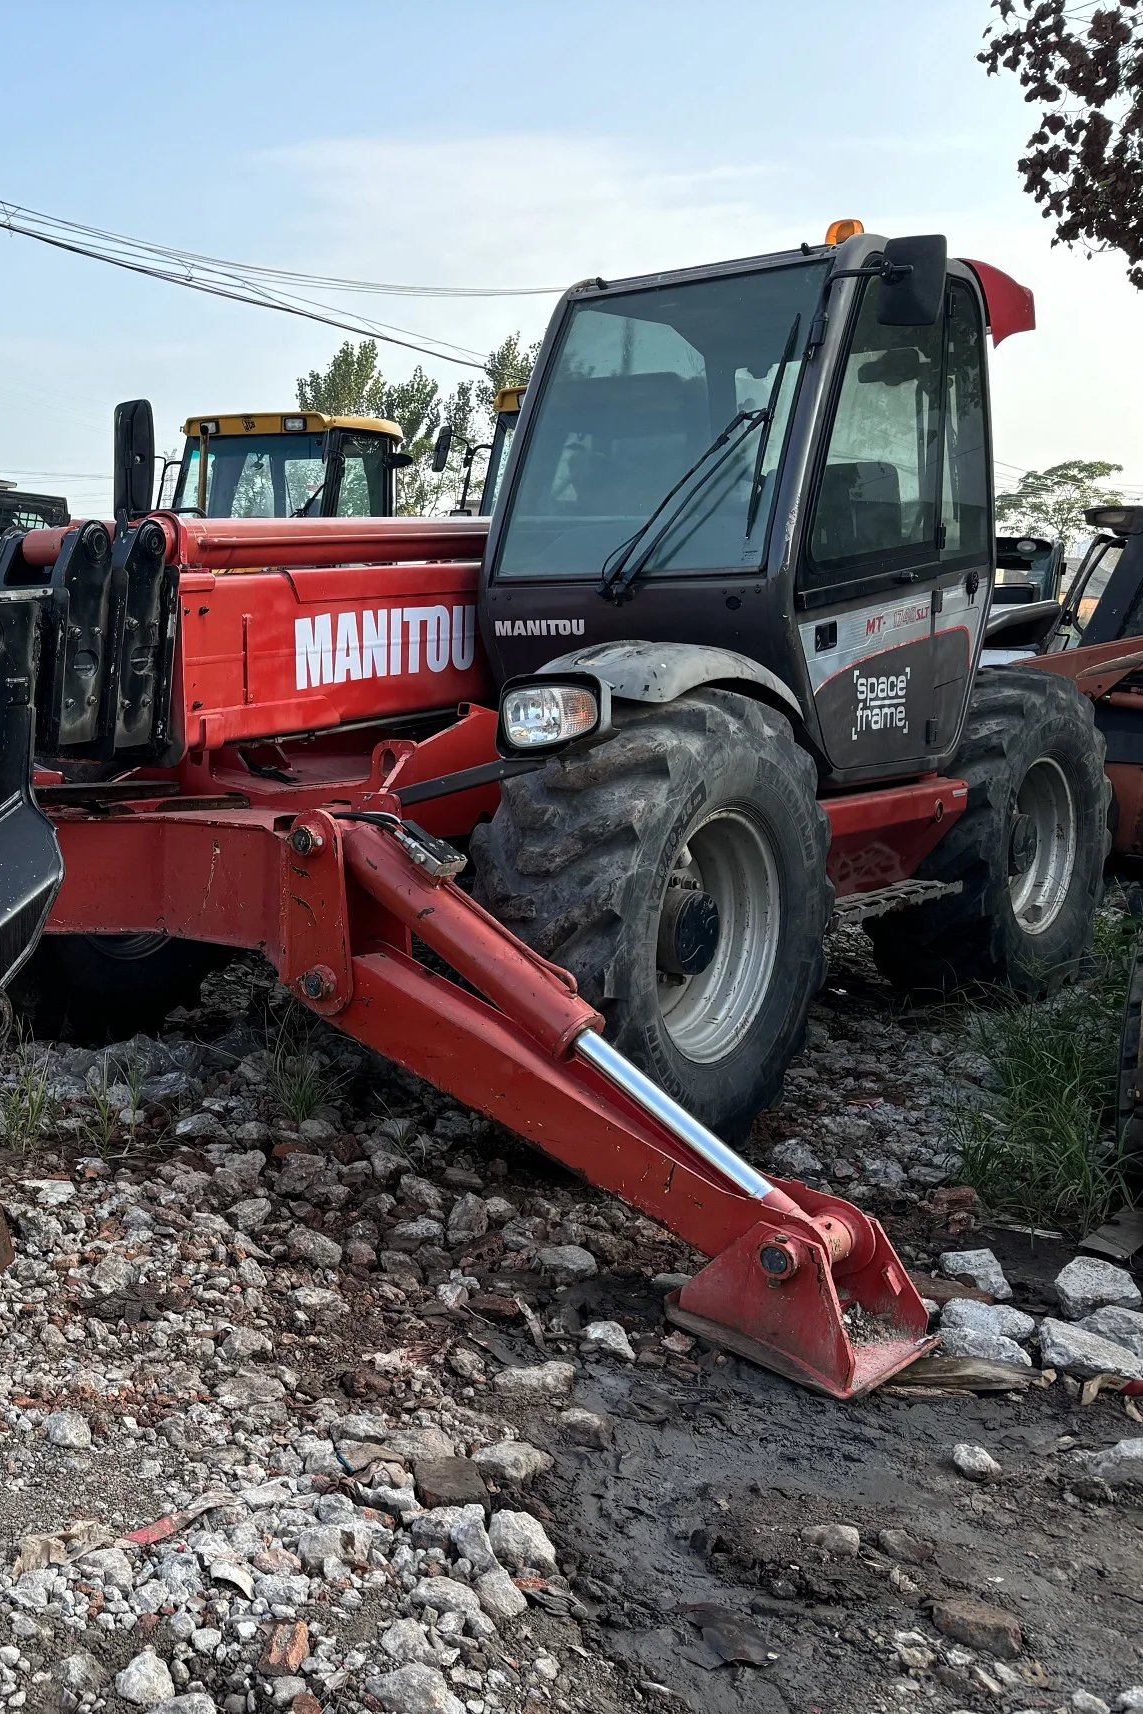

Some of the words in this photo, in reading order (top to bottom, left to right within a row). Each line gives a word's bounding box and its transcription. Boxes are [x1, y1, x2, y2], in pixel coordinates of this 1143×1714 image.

[495, 619, 585, 636] MANITOU
[295, 605, 476, 690] MANITOU
[857, 675, 906, 706] space
[856, 702, 906, 731] frame
